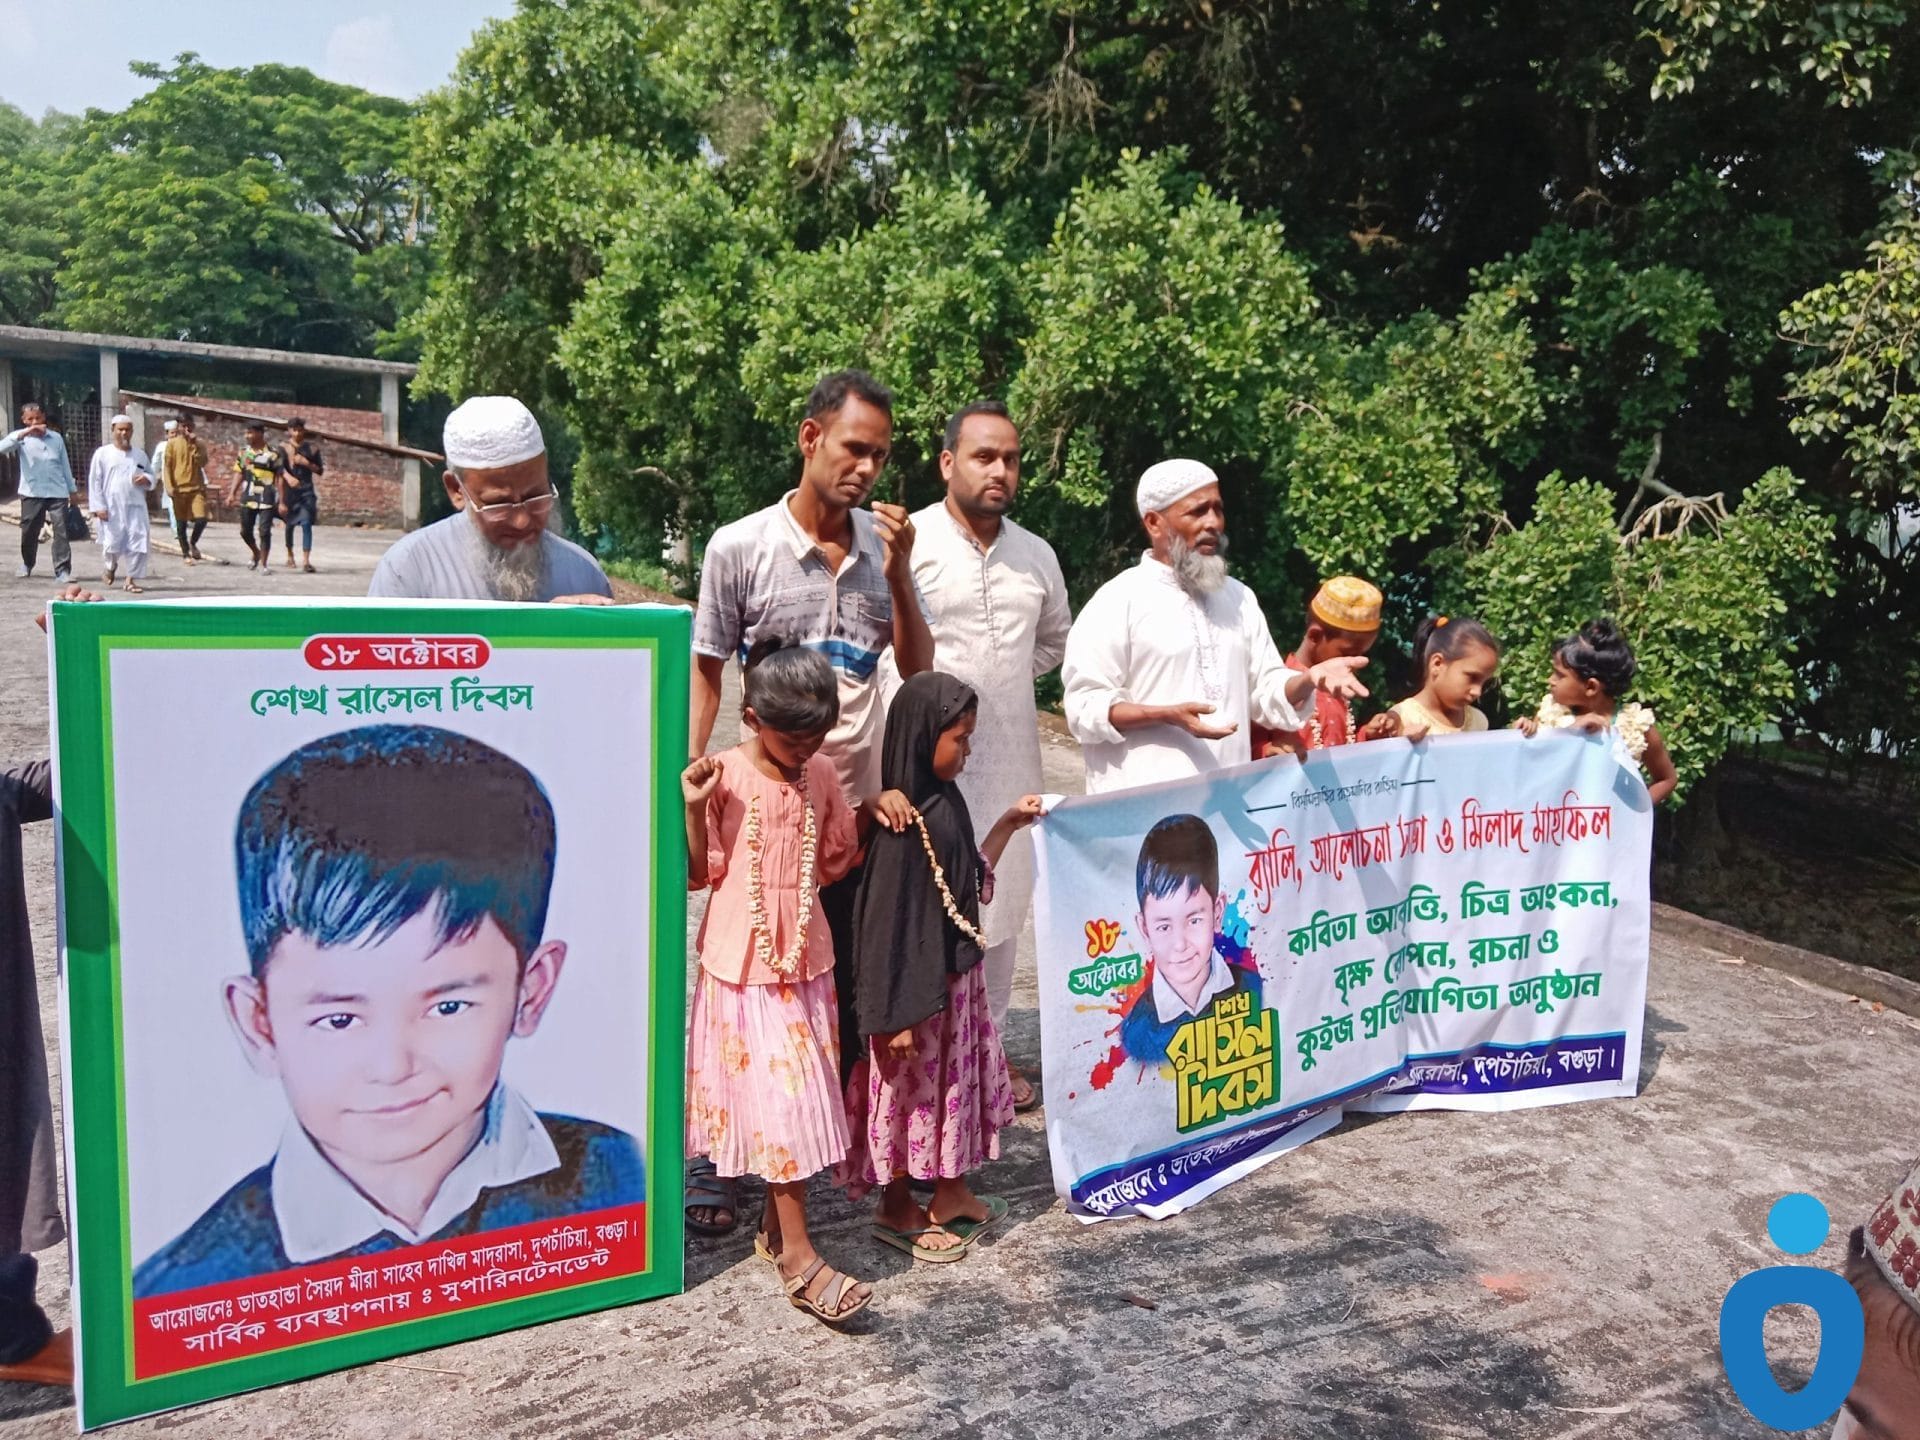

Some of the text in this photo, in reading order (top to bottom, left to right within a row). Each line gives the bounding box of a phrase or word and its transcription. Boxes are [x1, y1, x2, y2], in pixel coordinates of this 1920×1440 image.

[321, 638, 479, 667] ১৮ অক্টোবর
[250, 676, 534, 716] শেখ রাসেল দিবস
[1309, 822, 1392, 881] আলোচনা
[1436, 818, 1454, 853] ও
[1462, 798, 1530, 853] মিলাদ
[1531, 789, 1611, 846] মাহফিল
[1085, 918, 1121, 958] ১৮
[1287, 880, 1618, 957] কবিতা আবৃত্তি, চিত্র অংকন,
[1072, 958, 1139, 991] অক্টোবর
[1333, 958, 1375, 1006] বৃক্ষ
[1468, 933, 1531, 968] রচনা
[1537, 929, 1559, 954] ও
[1214, 991, 1251, 1025] শেখ
[1296, 1013, 1354, 1072] কুইজ
[1508, 968, 1602, 1014] অনুষ্ঠান
[1175, 1056, 1273, 1129] দিবস
[1557, 1046, 1605, 1074] বগুড়া
[304, 1276, 343, 1301] সৈয়দ
[348, 1266, 378, 1292] মীরা
[382, 1260, 424, 1285] সাহেব
[427, 1249, 467, 1276] দাখিল
[531, 1226, 592, 1260] দুপচাঁচিয়া,
[596, 1219, 628, 1243] বগুড়া
[182, 1318, 266, 1352] সার্বিক
[274, 1291, 412, 1334] ব্যবস্থাপনায়
[439, 1248, 611, 1302] সুপারিনটেনডেন্ট
